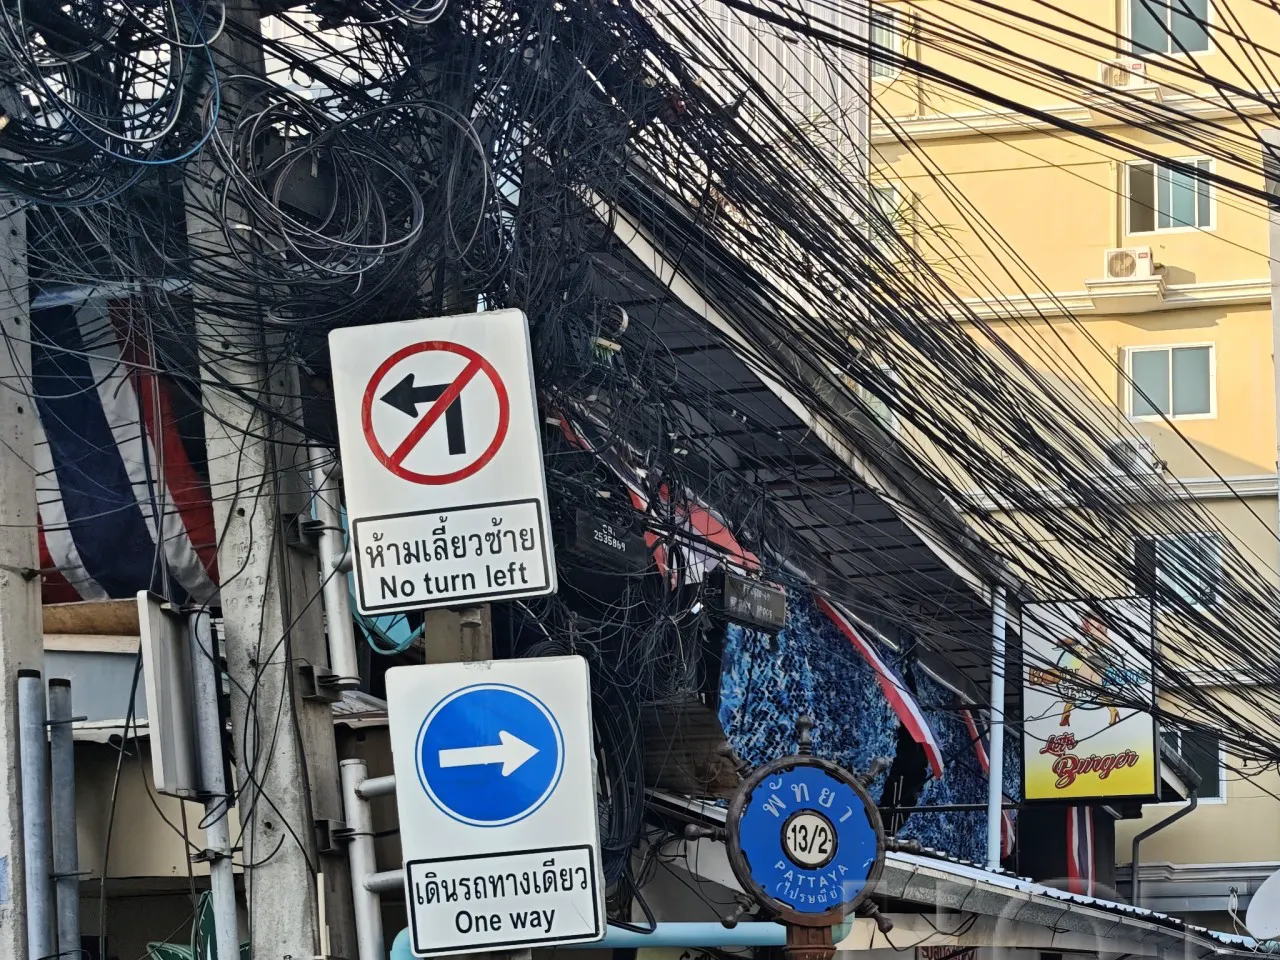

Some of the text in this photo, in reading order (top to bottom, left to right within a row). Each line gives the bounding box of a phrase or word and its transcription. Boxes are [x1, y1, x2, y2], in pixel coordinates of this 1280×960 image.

[365, 515, 535, 568] ห้ามเลี้ยวซ้าย
[379, 562, 528, 599] No turn left
[1052, 749, 1139, 790] Burger
[762, 778, 853, 823] พัทยา
[791, 824, 828, 854] 13/2
[415, 858, 588, 905] เดินรถทางเดียว
[774, 860, 849, 888] PATTAYA
[455, 909, 555, 934] One way
